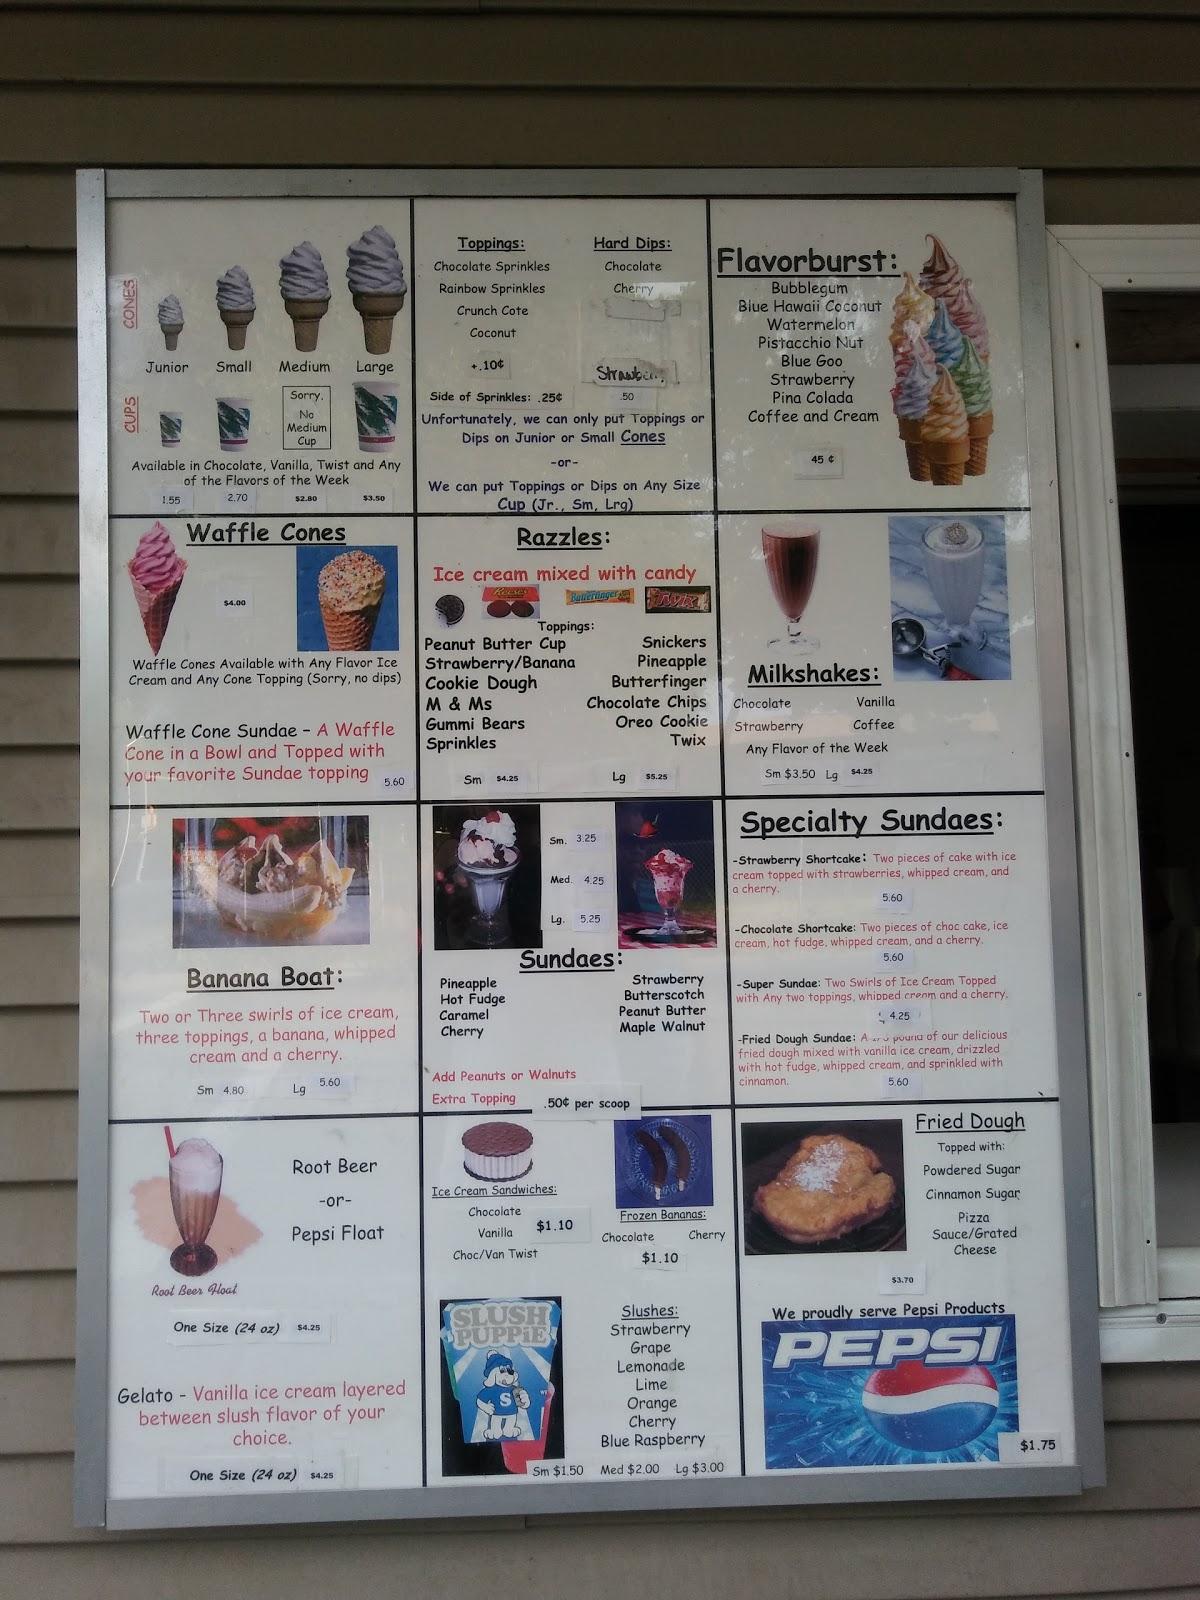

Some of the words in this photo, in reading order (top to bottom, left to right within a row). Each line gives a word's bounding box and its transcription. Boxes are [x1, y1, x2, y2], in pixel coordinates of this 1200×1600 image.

[458, 237, 525, 251] Toppings:
[594, 237, 631, 251] Hard
[636, 237, 672, 251] Dips:
[434, 261, 492, 272] Chocolate
[496, 261, 549, 275] Sprinkles
[605, 260, 662, 271] Chocolate
[717, 248, 901, 278] Flavorburst:
[440, 283, 486, 294] Rainbow
[491, 282, 545, 296] Sprinkles
[614, 283, 653, 296] Cherry
[772, 281, 851, 299] Bubblegum
[123, 279, 138, 329] CONES
[457, 305, 497, 317] Crunch
[502, 305, 528, 318] Cote
[767, 318, 855, 331] Watermelon
[470, 328, 516, 339] Coconut
[146, 361, 188, 373] Junior
[216, 360, 251, 373] Small
[279, 360, 330, 372] Medium
[357, 360, 394, 375] Large
[782, 355, 811, 367] Blue
[816, 355, 842, 368] Goo
[771, 373, 855, 389] Strawberry
[430, 392, 454, 401] Side
[459, 392, 471, 402] of
[476, 392, 530, 404] Sprinkles:
[773, 391, 801, 405] Pina
[807, 391, 853, 405] Colada
[124, 396, 139, 433] CUPS
[300, 409, 314, 419] No
[287, 422, 327, 432] Medium
[298, 436, 316, 449] Cup
[551, 459, 578, 467] -or-
[811, 455, 824, 464] 45
[828, 455, 834, 463] ¢
[163, 496, 181, 504] 1.55
[228, 492, 248, 502] 2.70
[186, 522, 269, 546] Waffle
[280, 522, 346, 546] Cones
[517, 526, 610, 550] Razzles:
[537, 621, 594, 634] Toppings:
[642, 635, 706, 648] Snickers
[425, 655, 575, 673] Strawberry/Banana
[638, 653, 707, 671] Pineapple
[747, 663, 882, 688] Milkshakes:
[425, 675, 479, 690] Cookie
[488, 675, 537, 693] Dough
[612, 674, 706, 691] Butterfinger
[587, 695, 660, 709] Chocolate
[667, 695, 706, 712] Chips
[734, 698, 791, 709] Chocolate
[857, 696, 895, 707] Vanilla
[426, 717, 474, 731] Gummi
[482, 717, 525, 730] Bears
[735, 721, 803, 734] Strawberry
[854, 719, 894, 730] Coffee
[426, 736, 496, 754] Sprinkles
[670, 734, 706, 746] Twix
[385, 777, 404, 786] 5.60
[464, 775, 481, 784] Sm
[613, 772, 626, 784] Lg
[765, 769, 781, 778] Sm
[785, 768, 815, 780] $3.50
[826, 770, 838, 782] Lg
[741, 807, 867, 840] Specialty
[881, 807, 1003, 840] Sundaes:
[577, 834, 596, 842] 3.25
[733, 853, 800, 867] -Strawberry
[806, 853, 866, 867] Shortcake:
[551, 875, 572, 883] Med.
[584, 876, 604, 885] 4.25
[883, 893, 902, 902] 5.60
[551, 915, 565, 925] Lg.
[581, 915, 600, 923] 5.25
[735, 923, 793, 935] -Chocolate
[797, 923, 856, 935] Shortcake:
[519, 948, 622, 973] Sundaes:
[884, 953, 903, 962] 5.60
[186, 966, 269, 993] Banana
[281, 966, 342, 993] Boat:
[441, 977, 497, 992] Pineapple
[632, 973, 704, 989] Strawberry
[625, 989, 704, 1001] Butterscotch
[440, 1009, 488, 1020] Caramel
[890, 1011, 910, 1020] 4.25
[441, 1025, 483, 1039] Cherry
[293, 1084, 306, 1096] Lg
[320, 1077, 341, 1087] 5.60
[889, 1077, 908, 1086] 5.60
[197, 1085, 213, 1095] Sm
[223, 1086, 244, 1095] 4.80
[575, 1101, 593, 1111] per
[599, 1101, 630, 1111] scoop
[916, 1112, 964, 1133] Fried
[971, 1112, 1026, 1133] Dough
[293, 1160, 331, 1174] Root
[339, 1158, 377, 1173] Beer
[924, 1164, 981, 1175] Powdered
[986, 1164, 1020, 1177] Sugar
[432, 1183, 452, 1198] Ice
[454, 1183, 488, 1198] Cream
[491, 1183, 558, 1198] Sandwiches:
[926, 1189, 981, 1199] Cinnamon
[986, 1188, 1020, 1201] Sugar
[320, 1196, 351, 1207] -or-
[469, 1206, 521, 1216] Chocolate
[620, 1209, 657, 1223] Frozen
[661, 1209, 707, 1223] Bananas:
[959, 1212, 989, 1223] Pizza
[478, 1227, 512, 1238] Vanilla
[537, 1220, 573, 1234] $1.10
[932, 1227, 1017, 1240] Sauce/Grated
[293, 1226, 334, 1246] Pepsi
[342, 1225, 384, 1241] Float
[602, 1232, 654, 1245] Chocolate
[689, 1230, 725, 1242] Cherry
[954, 1244, 997, 1255] Cheese
[642, 1251, 678, 1264] $1.10
[453, 1305, 548, 1327] SLUSH
[621, 1305, 679, 1319] Slushes:
[174, 1322, 197, 1332] One
[203, 1322, 228, 1333] Size
[235, 1322, 256, 1335] (24
[260, 1323, 280, 1336] oz)
[611, 1323, 690, 1338] Strawberry
[631, 1341, 671, 1357] Grape
[772, 1326, 1002, 1369] PEPSI
[618, 1359, 685, 1373] Lemonade
[636, 1378, 668, 1391] Lime
[627, 1397, 677, 1412] Orange
[629, 1415, 676, 1430] Cherry
[1021, 1439, 1055, 1453] $1.75
[533, 1467, 549, 1476] Sm
[553, 1465, 583, 1477] $1.50
[601, 1464, 623, 1475] Med
[628, 1463, 659, 1476] $2.00
[676, 1464, 688, 1476] Lg
[691, 1462, 724, 1474] $3.00
